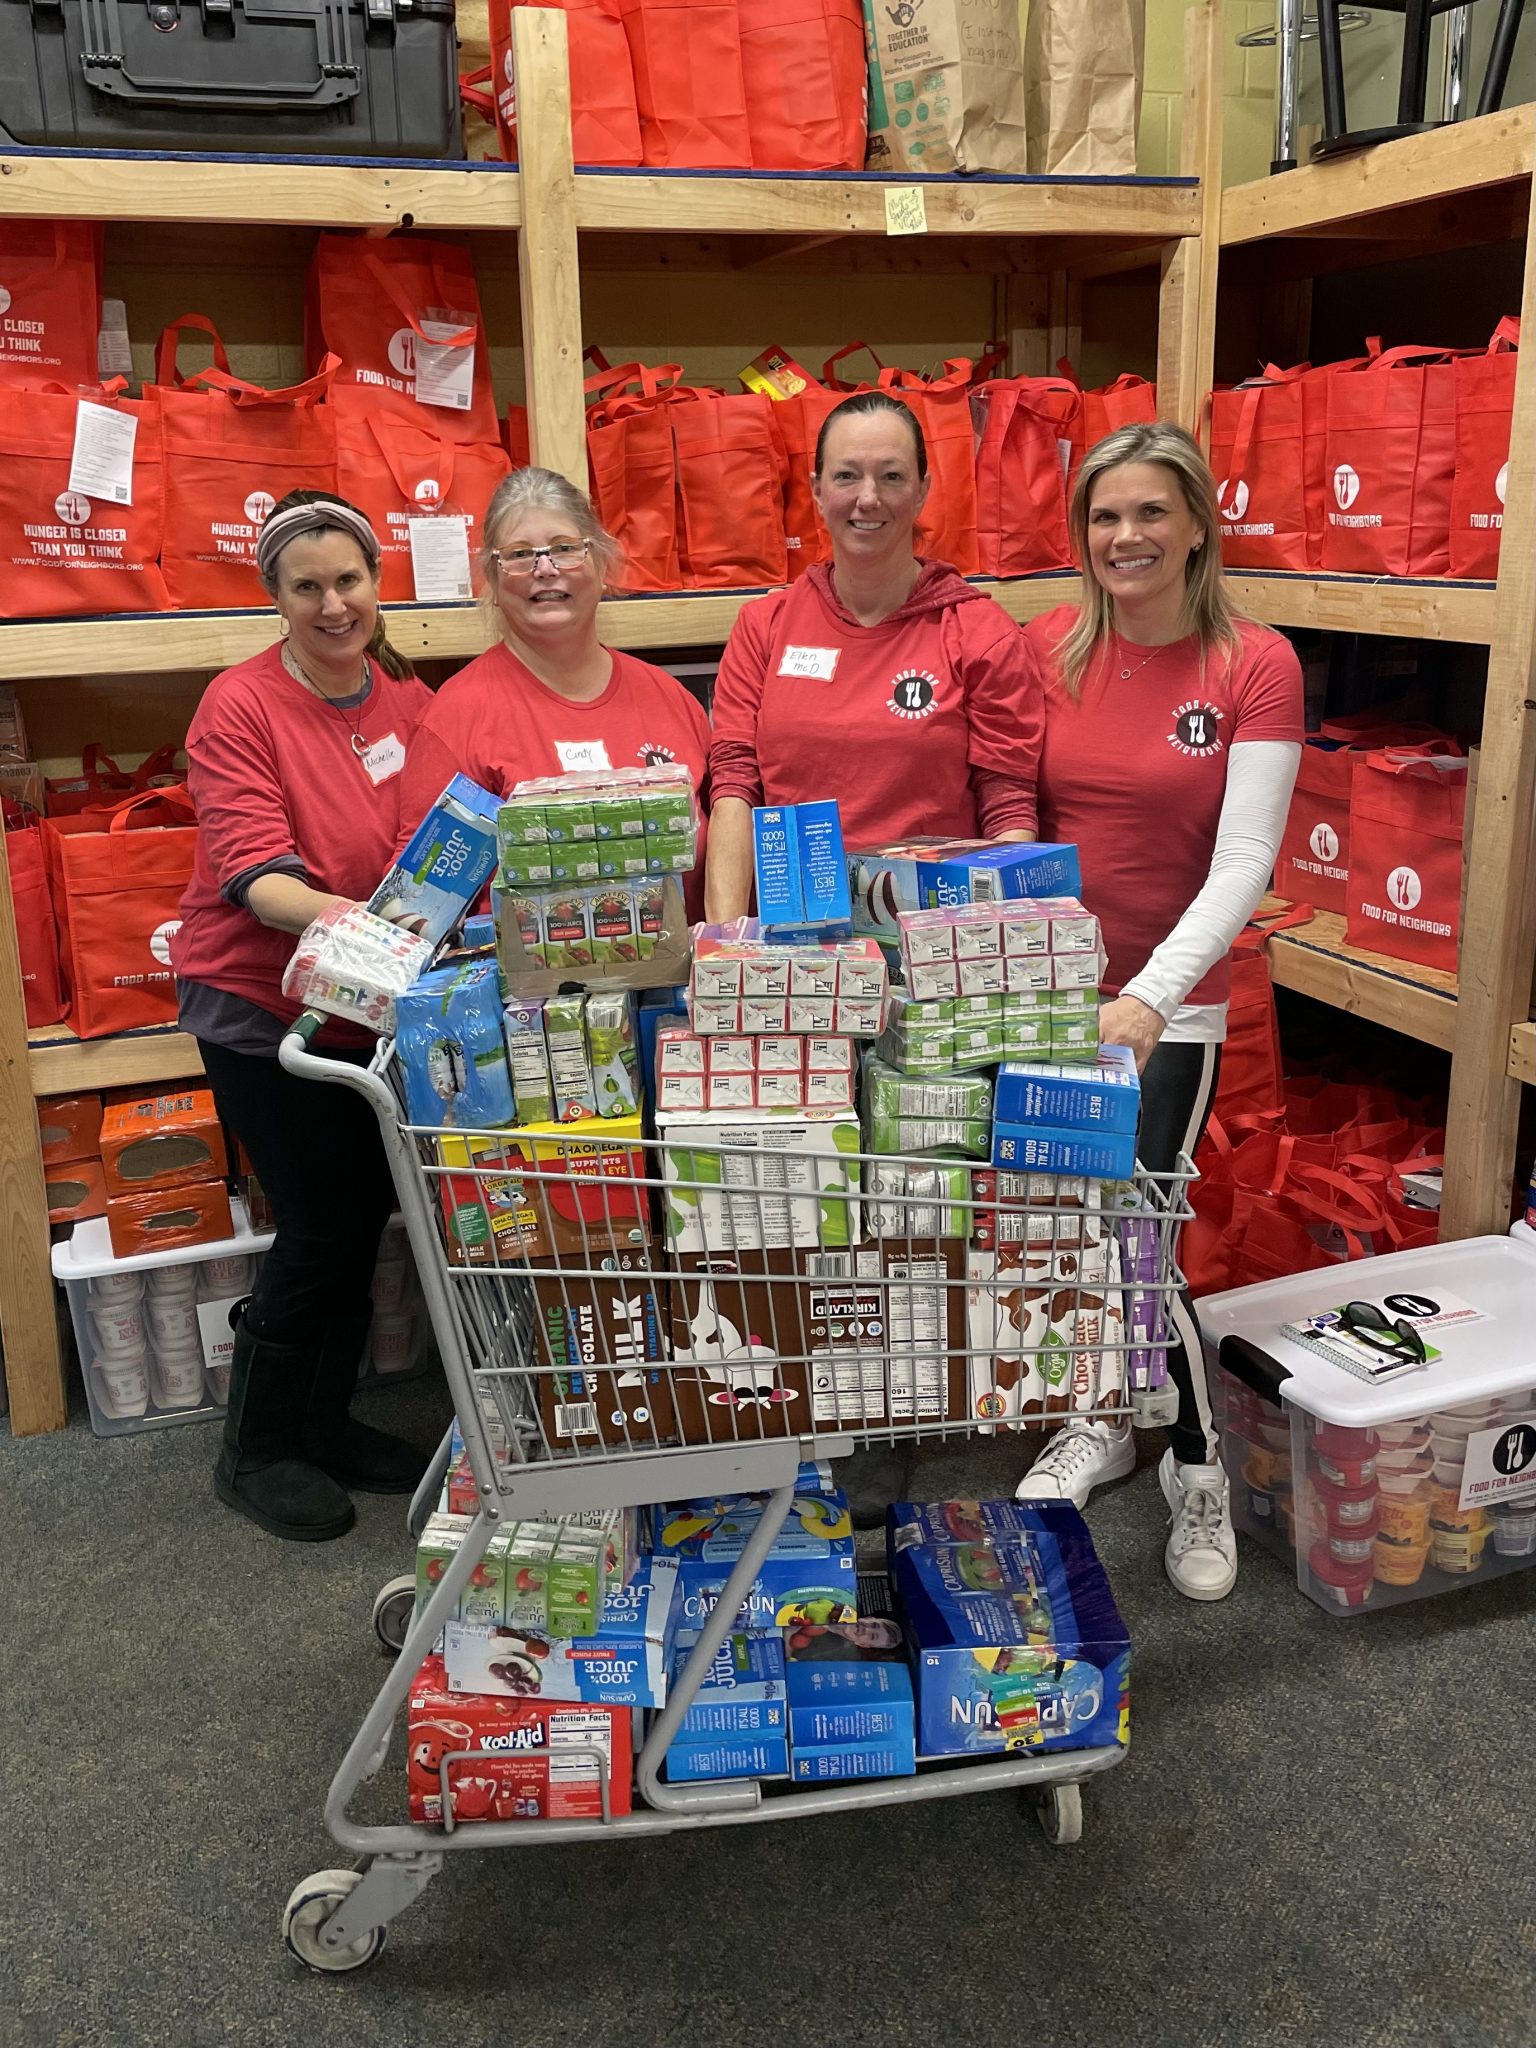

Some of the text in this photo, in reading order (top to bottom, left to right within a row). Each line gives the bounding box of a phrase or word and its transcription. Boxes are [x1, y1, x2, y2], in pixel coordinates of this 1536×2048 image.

[888, 25, 928, 43] TOGETHER IN
[888, 35, 930, 52] EDUCATION
[4, 319, 45, 335] CLOSER
[8, 337, 41, 352] THINK
[356, 369, 403, 393] FOOD FOR
[1220, 523, 1275, 536] FOR NEIGHBORS
[1470, 514, 1503, 529] FOOD FO
[23, 524, 127, 541] HUNGER IS CLOSER
[211, 523, 253, 538] HUNGER
[391, 528, 410, 541] THA
[30, 541, 124, 559] THAN YOU THINK
[216, 540, 245, 554] THAN
[890, 668, 940, 687] FOOD FOR
[885, 699, 939, 720] NEIGHBORS
[1171, 699, 1224, 720] FOOD FOR
[1166, 733, 1224, 758] NEIGHBORS
[430, 829, 464, 878] JUICE
[761, 841, 786, 852] IT'S ALL
[446, 844, 472, 879] 100%
[1292, 857, 1323, 875] FOOD FOR
[813, 877, 835, 889] BEST
[565, 919, 583, 928] JUICE
[612, 915, 630, 924] JUICE
[1361, 903, 1452, 937] FOOD FOR NEIGHBORS
[114, 971, 170, 988] FOOD FOR
[1089, 1095, 1102, 1120] BEST
[1037, 1141, 1050, 1167] IT'S ALL
[608, 1166, 627, 1175] EYE
[494, 1217, 507, 1227] DHA
[497, 1224, 537, 1238] CHOCLATE
[469, 1245, 484, 1253] MILK
[815, 1302, 877, 1315] KIRKLAD
[1087, 1317, 1100, 1343] MILK
[212, 1343, 233, 1354] FOOD
[579, 1304, 598, 1394] CHCOLATE
[611, 1294, 647, 1388] MILK
[1048, 1338, 1066, 1380] Orgac
[1069, 1315, 1090, 1395] Choclate
[891, 1387, 907, 1395] 160
[1469, 1482, 1489, 1495] FOOD
[1490, 1478, 1506, 1490] FOR
[465, 1606, 500, 1619] Juicy
[469, 1600, 498, 1610] Juice
[514, 1605, 543, 1615] Juice
[510, 1611, 545, 1624] Juicy
[594, 1651, 611, 1659] FRUIT
[926, 1657, 940, 1666] 10
[584, 1660, 639, 1673] JUICE
[591, 1672, 631, 1684] 100%
[550, 1713, 611, 1723] Nutrition Facts
[738, 1706, 748, 1729] IT'S ALL
[872, 1714, 883, 1733] BEST
[480, 1722, 545, 1750] Kool-Aid
[1013, 1735, 1036, 1747] 30
[699, 1753, 711, 1772] BEST
[829, 1755, 839, 1777] IT'S ALL
